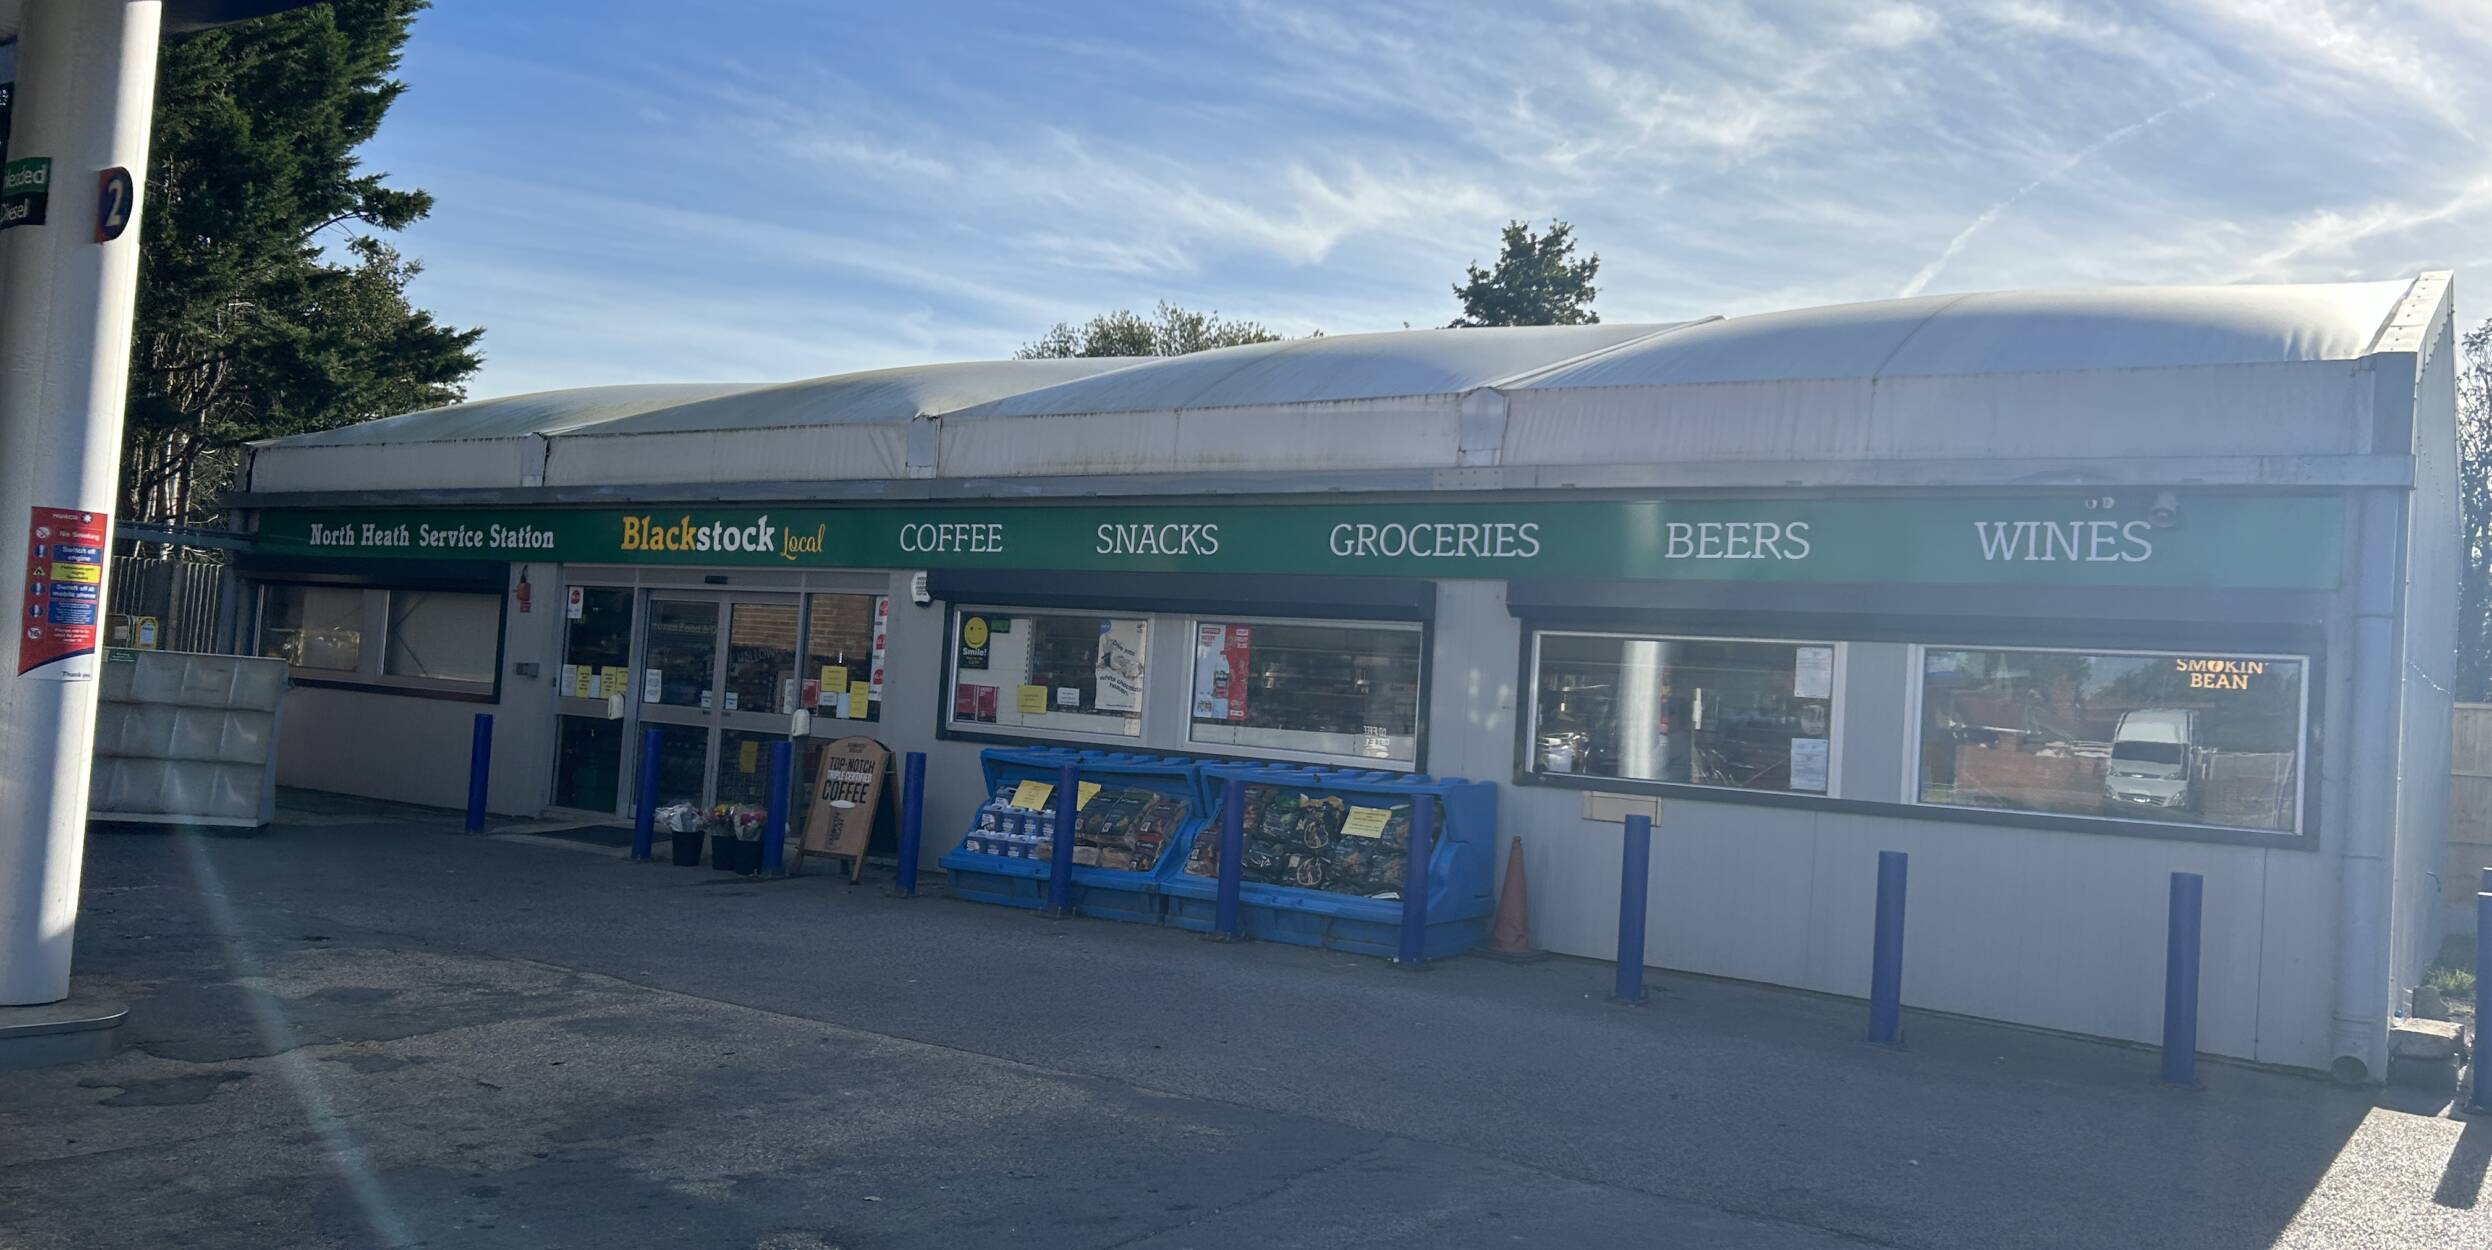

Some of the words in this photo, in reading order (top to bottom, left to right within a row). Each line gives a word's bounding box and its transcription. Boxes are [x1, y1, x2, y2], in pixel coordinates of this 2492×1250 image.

[106, 179, 124, 227] 2
[310, 523, 354, 546] North
[361, 523, 409, 547] Heath
[419, 523, 483, 548] Service
[489, 523, 554, 549] Station
[620, 514, 776, 552] Blackstock
[780, 523, 825, 561] Local
[900, 523, 1003, 553] COFFEE
[1096, 523, 1218, 555] SNACKS
[1329, 523, 1540, 558] GROCERIES
[1664, 521, 1811, 561] BEERS
[1974, 520, 2153, 563] WINES
[962, 647, 988, 657] Smile!
[2176, 659, 2270, 674] SMOKIN'
[2189, 673, 2249, 690] BEAN
[831, 756, 876, 773] TOP-NOTCH
[821, 780, 871, 804] COFFEE
